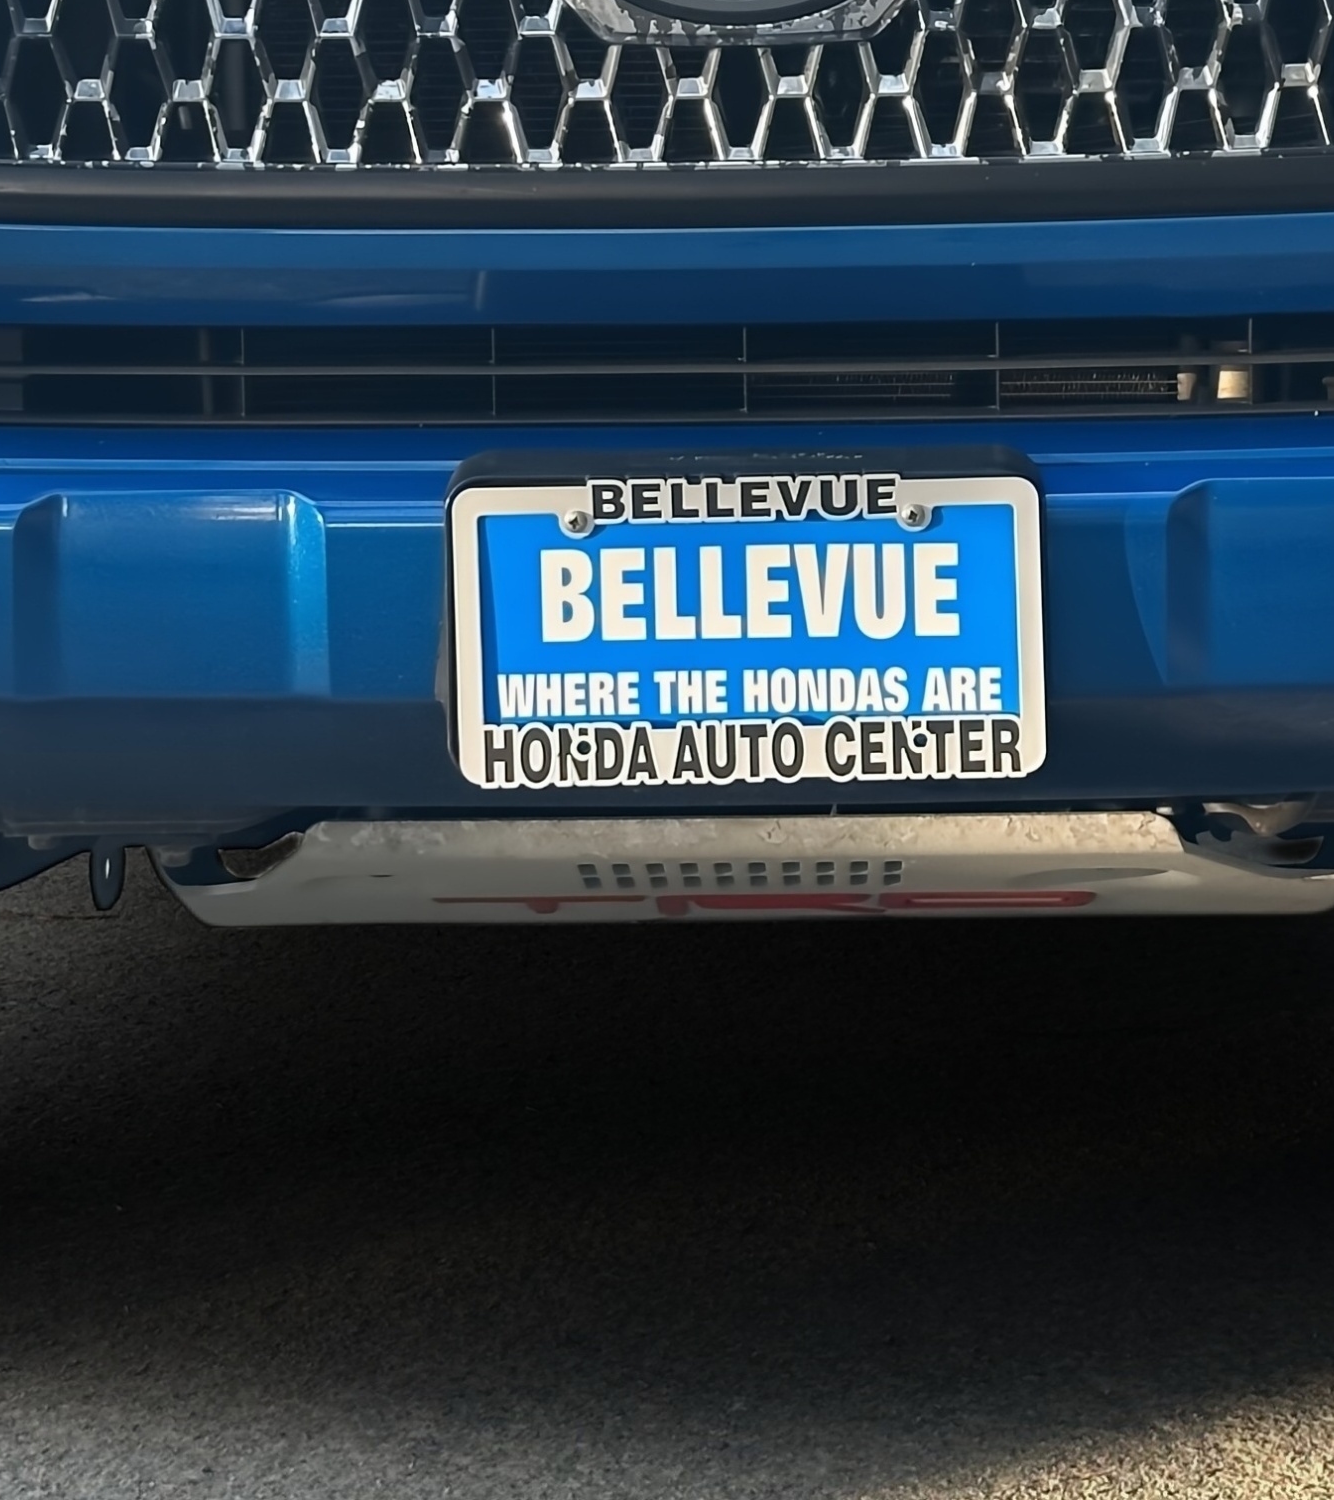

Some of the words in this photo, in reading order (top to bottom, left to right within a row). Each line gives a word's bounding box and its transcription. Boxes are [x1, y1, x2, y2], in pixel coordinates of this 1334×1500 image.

[592, 477, 898, 521] BELLEVUE
[540, 542, 960, 642] BELLEVUE
[497, 672, 641, 718] WHERE
[653, 669, 727, 714] THE
[742, 668, 908, 713] HONDAS
[921, 666, 1002, 711] ARE
[484, 726, 660, 784] HONDA
[672, 723, 804, 779] AUTO
[825, 719, 1023, 777] CENTER
